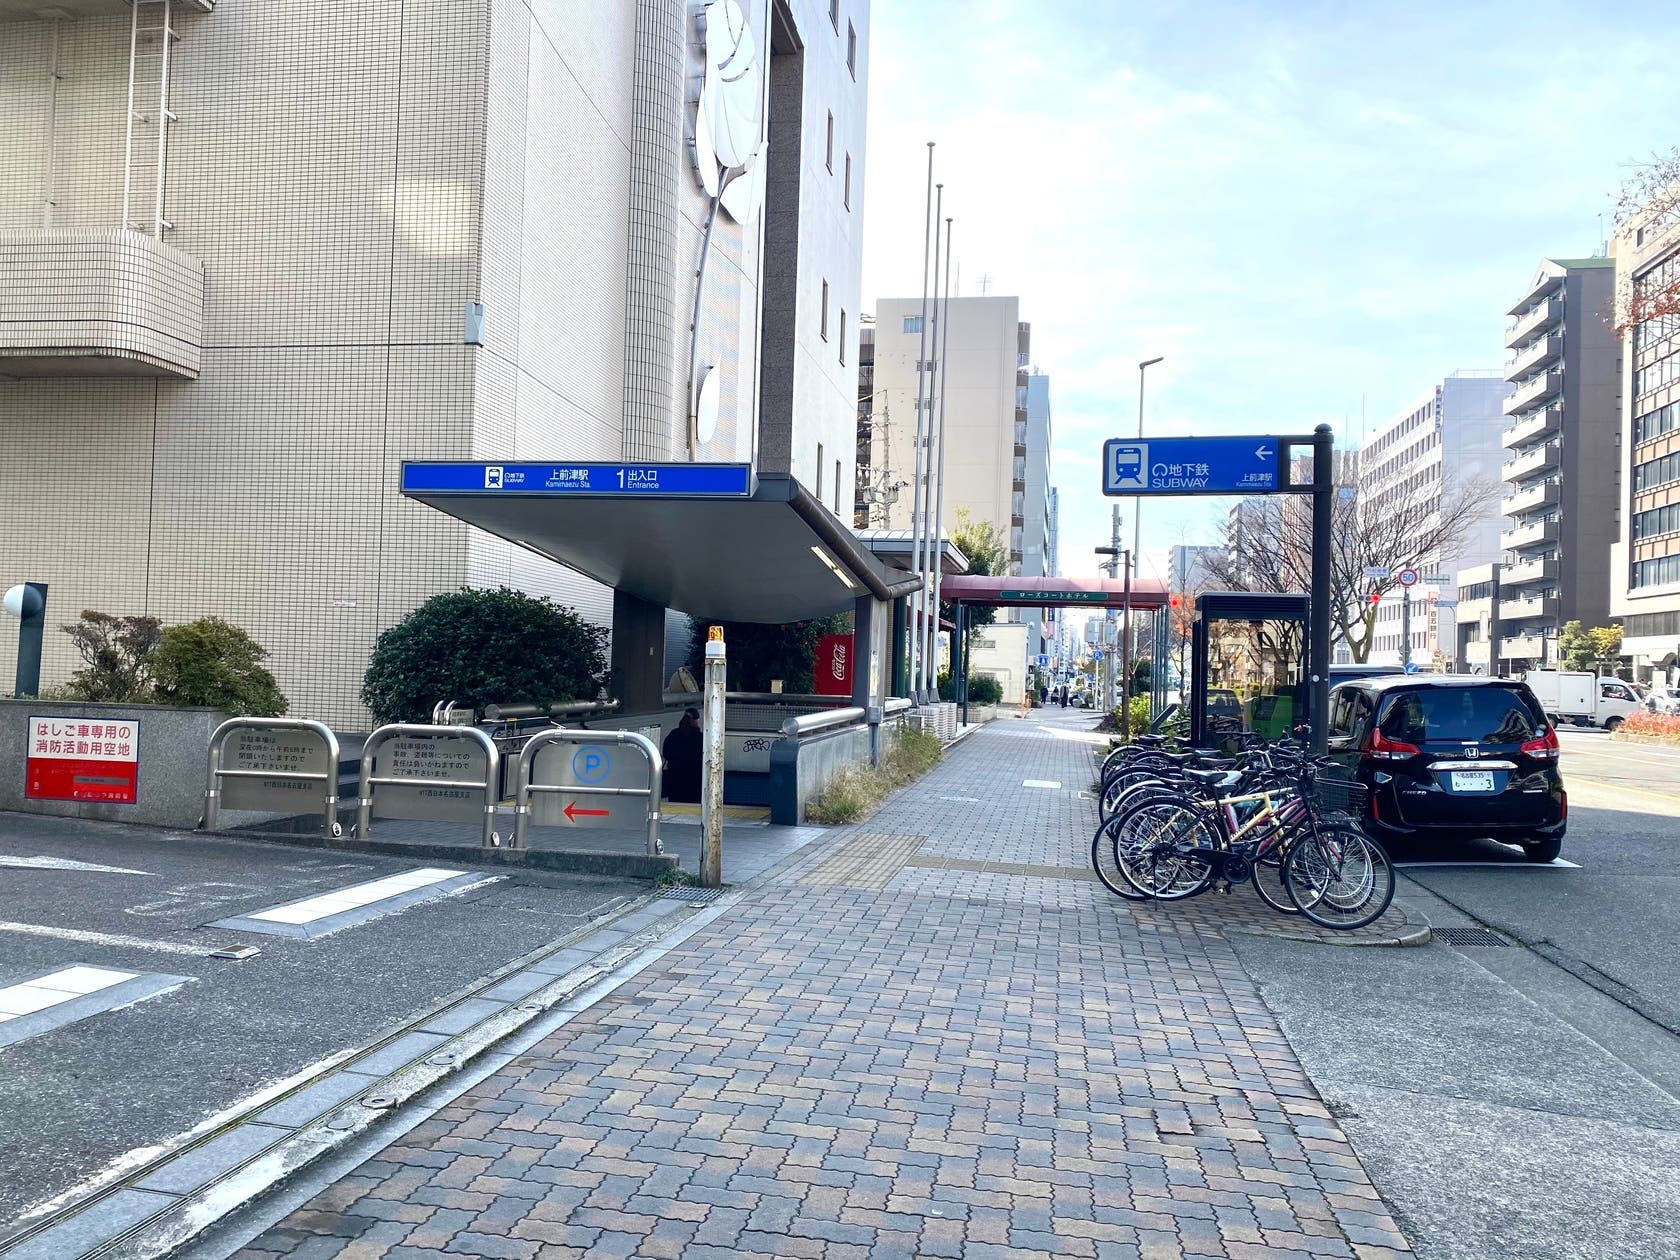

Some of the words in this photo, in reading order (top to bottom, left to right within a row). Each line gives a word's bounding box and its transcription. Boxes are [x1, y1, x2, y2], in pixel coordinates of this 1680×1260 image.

[549, 469, 589, 481] 上前津駅
[627, 470, 658, 481] 出入口
[1169, 463, 1209, 477] 地下鉄
[616, 468, 625, 489] 1
[1152, 477, 1209, 488] SUBWAY
[1242, 472, 1273, 482] 上前津駅
[545, 480, 579, 488] Kamimaezu
[627, 481, 660, 489] Entrance
[1402, 573, 1414, 582] 50
[1020, 592, 1089, 600] ローズコートホテル
[832, 642, 846, 680] Coca-Cola
[37, 723, 131, 739] はしご車専用の
[35, 740, 130, 756] 消防活動用空地
[393, 742, 435, 751] 当駐車場内の
[392, 759, 470, 770] 責任は負いかねますので
[585, 754, 601, 775] P
